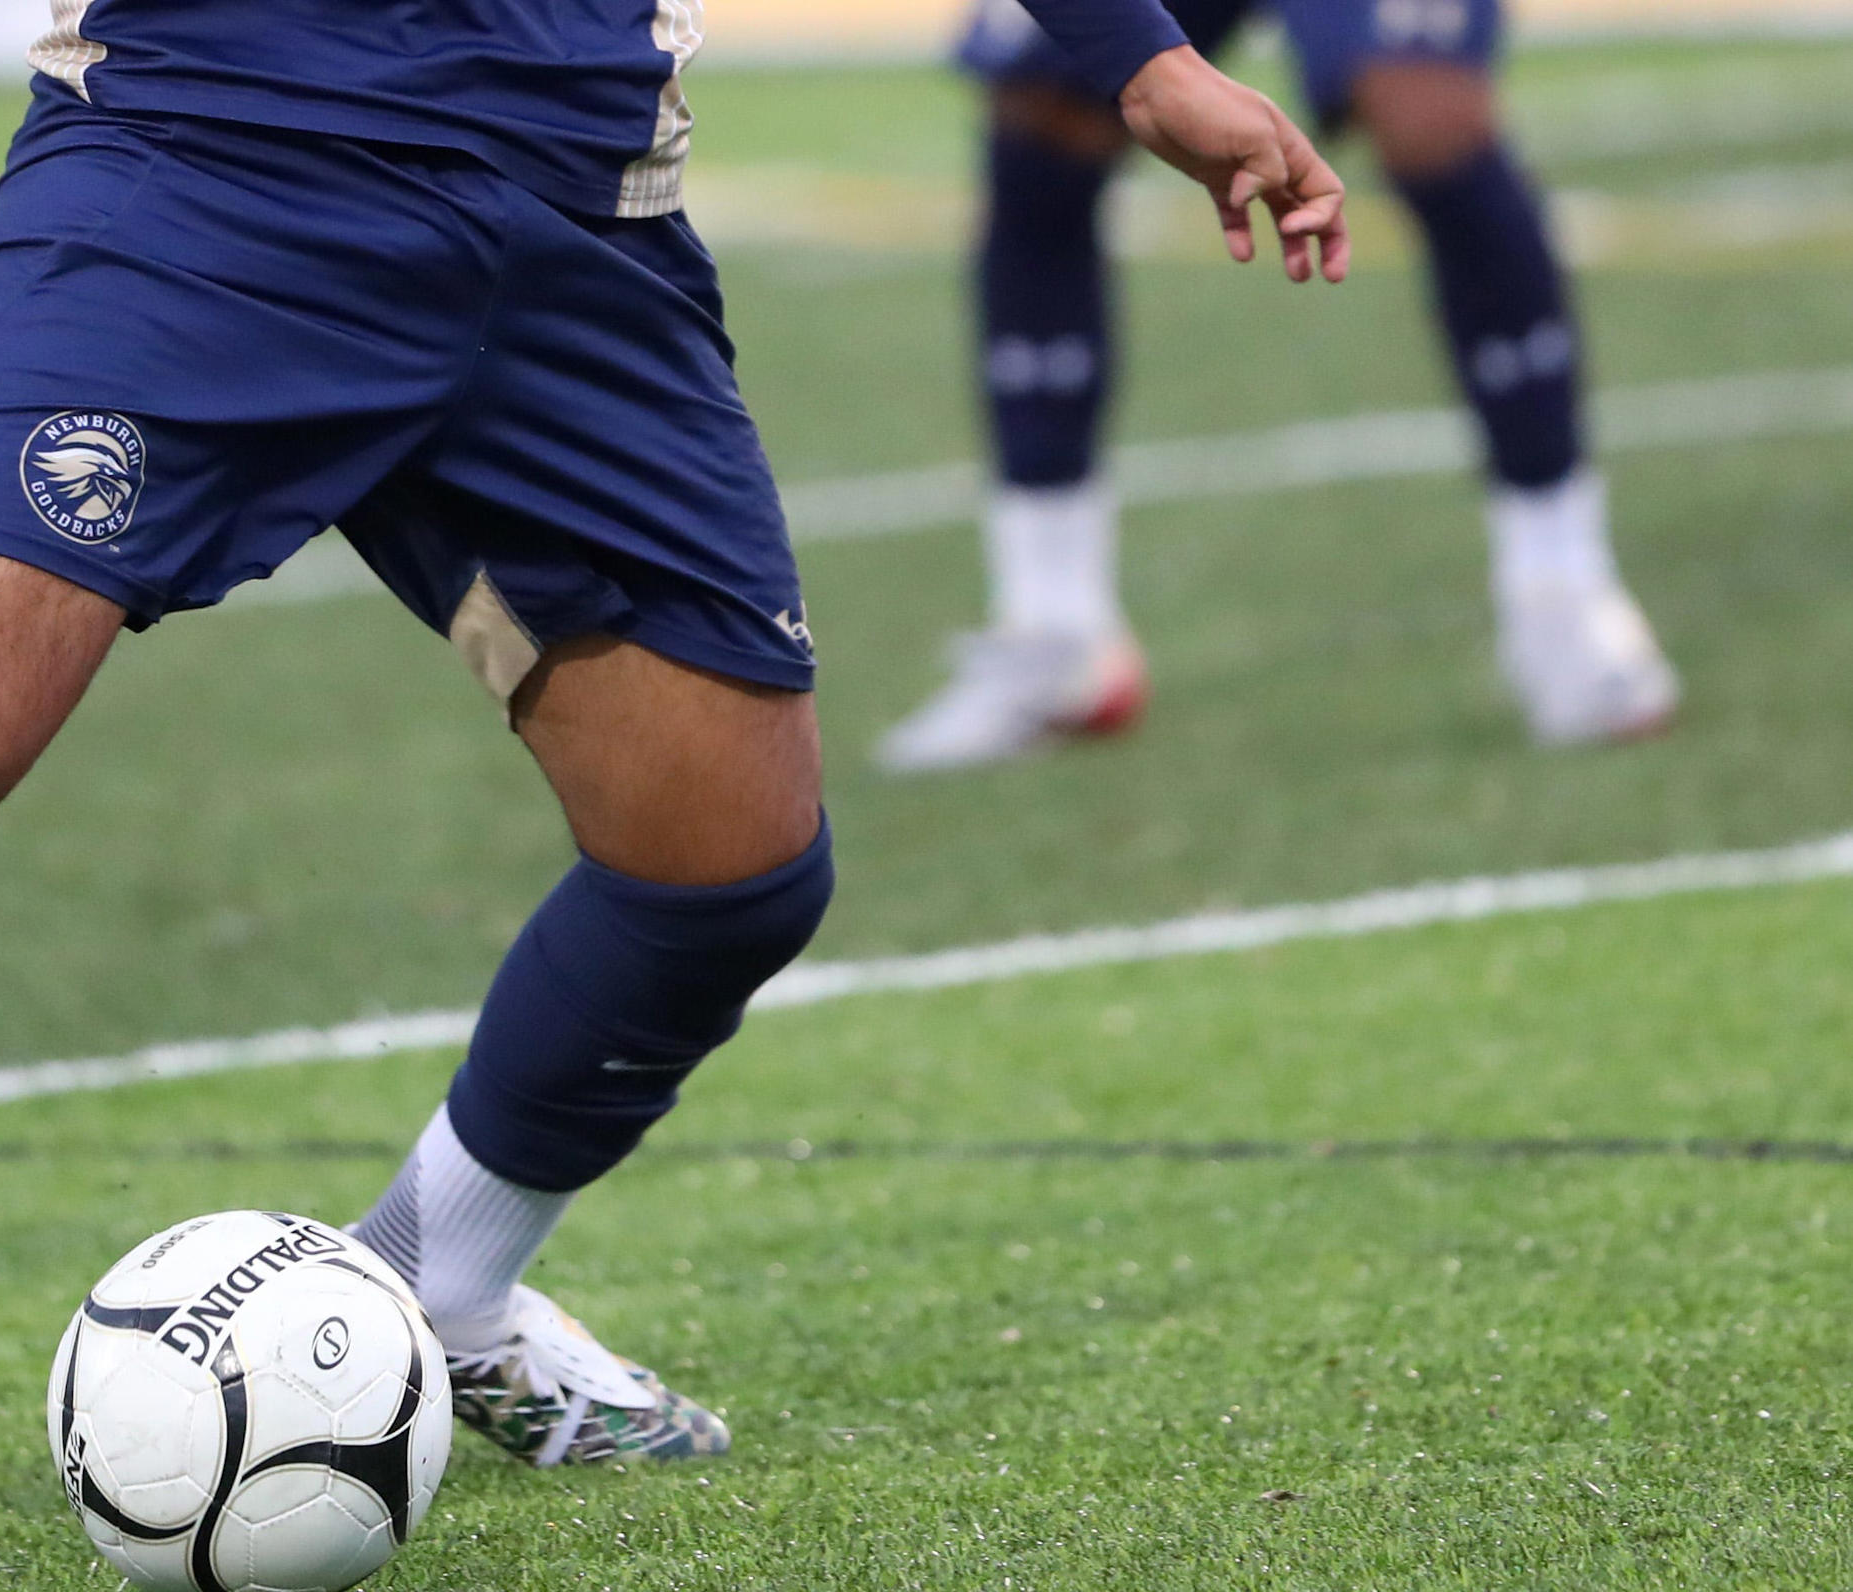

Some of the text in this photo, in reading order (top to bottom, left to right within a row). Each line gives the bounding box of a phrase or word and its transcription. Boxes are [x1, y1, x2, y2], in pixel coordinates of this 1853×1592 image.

[44, 415, 140, 465] NEWBURGH
[31, 480, 125, 537] GOLDBACKS
[160, 1225, 347, 1365] SPALDING
